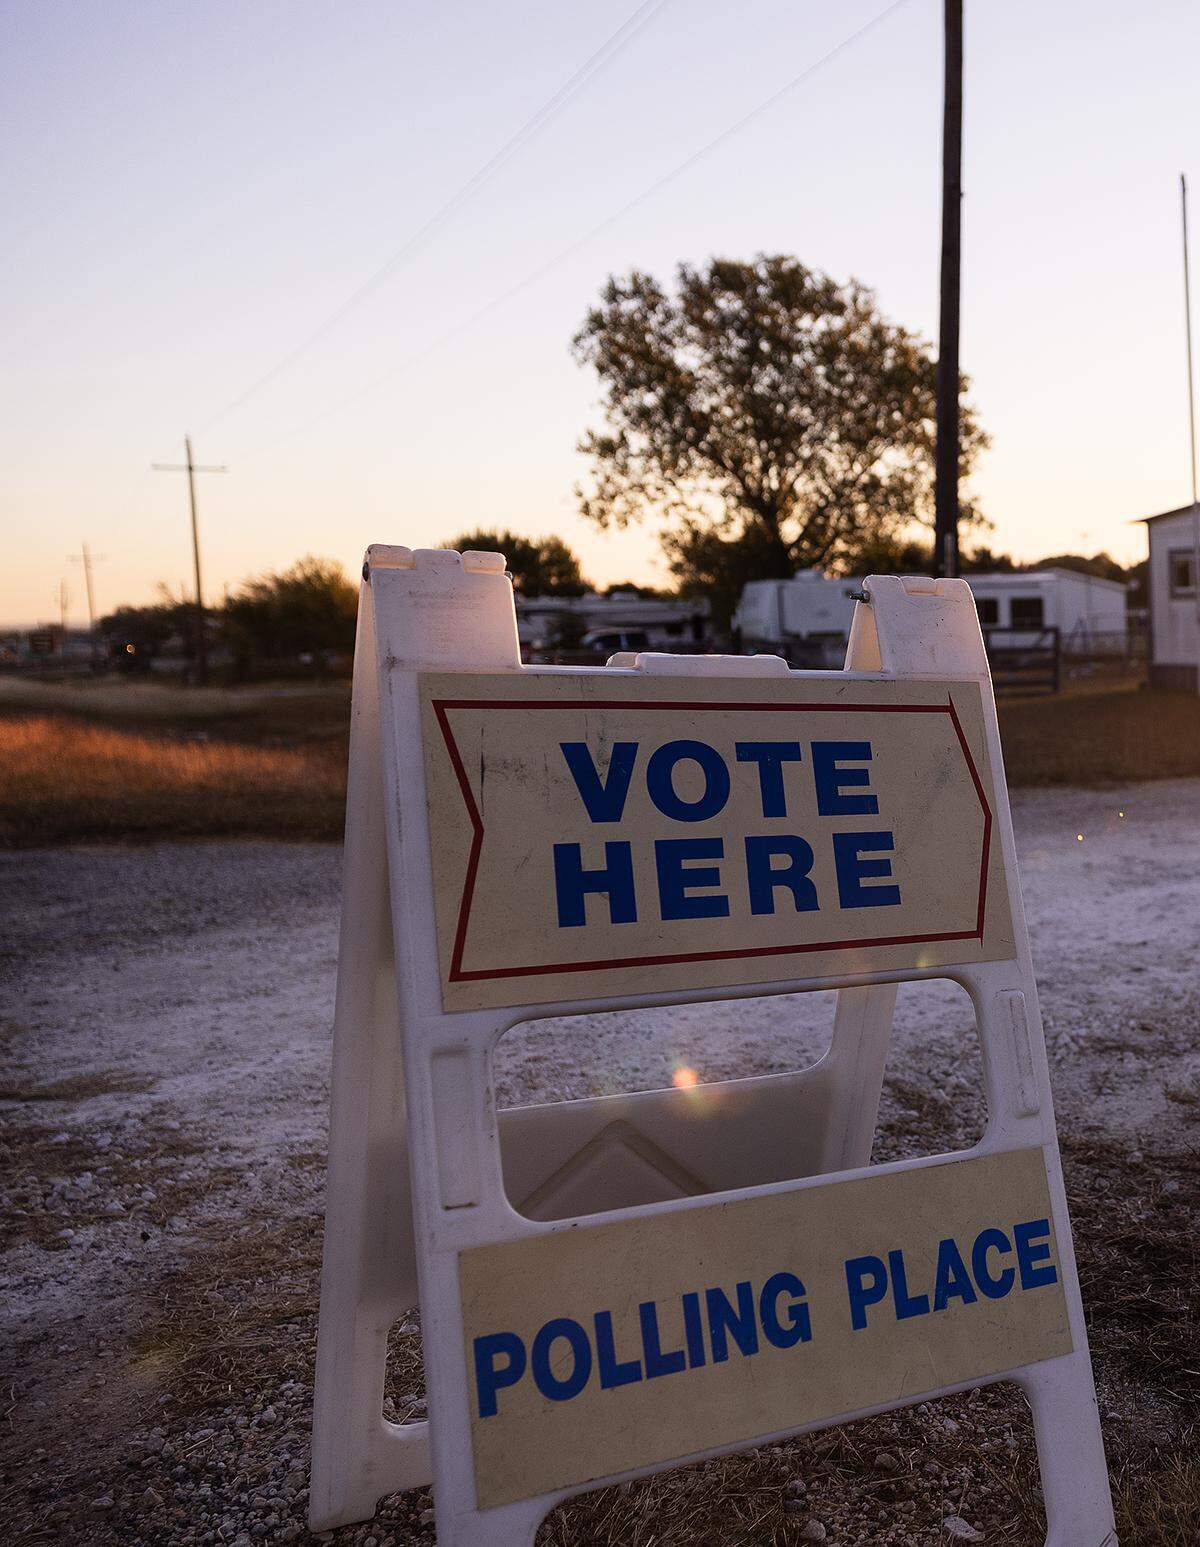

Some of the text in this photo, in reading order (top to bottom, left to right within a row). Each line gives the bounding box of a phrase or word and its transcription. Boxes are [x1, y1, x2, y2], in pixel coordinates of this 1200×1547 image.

[559, 739, 881, 824] VOTE
[553, 831, 902, 929] HERE
[473, 1218, 1059, 1418] POLLING PLACE
